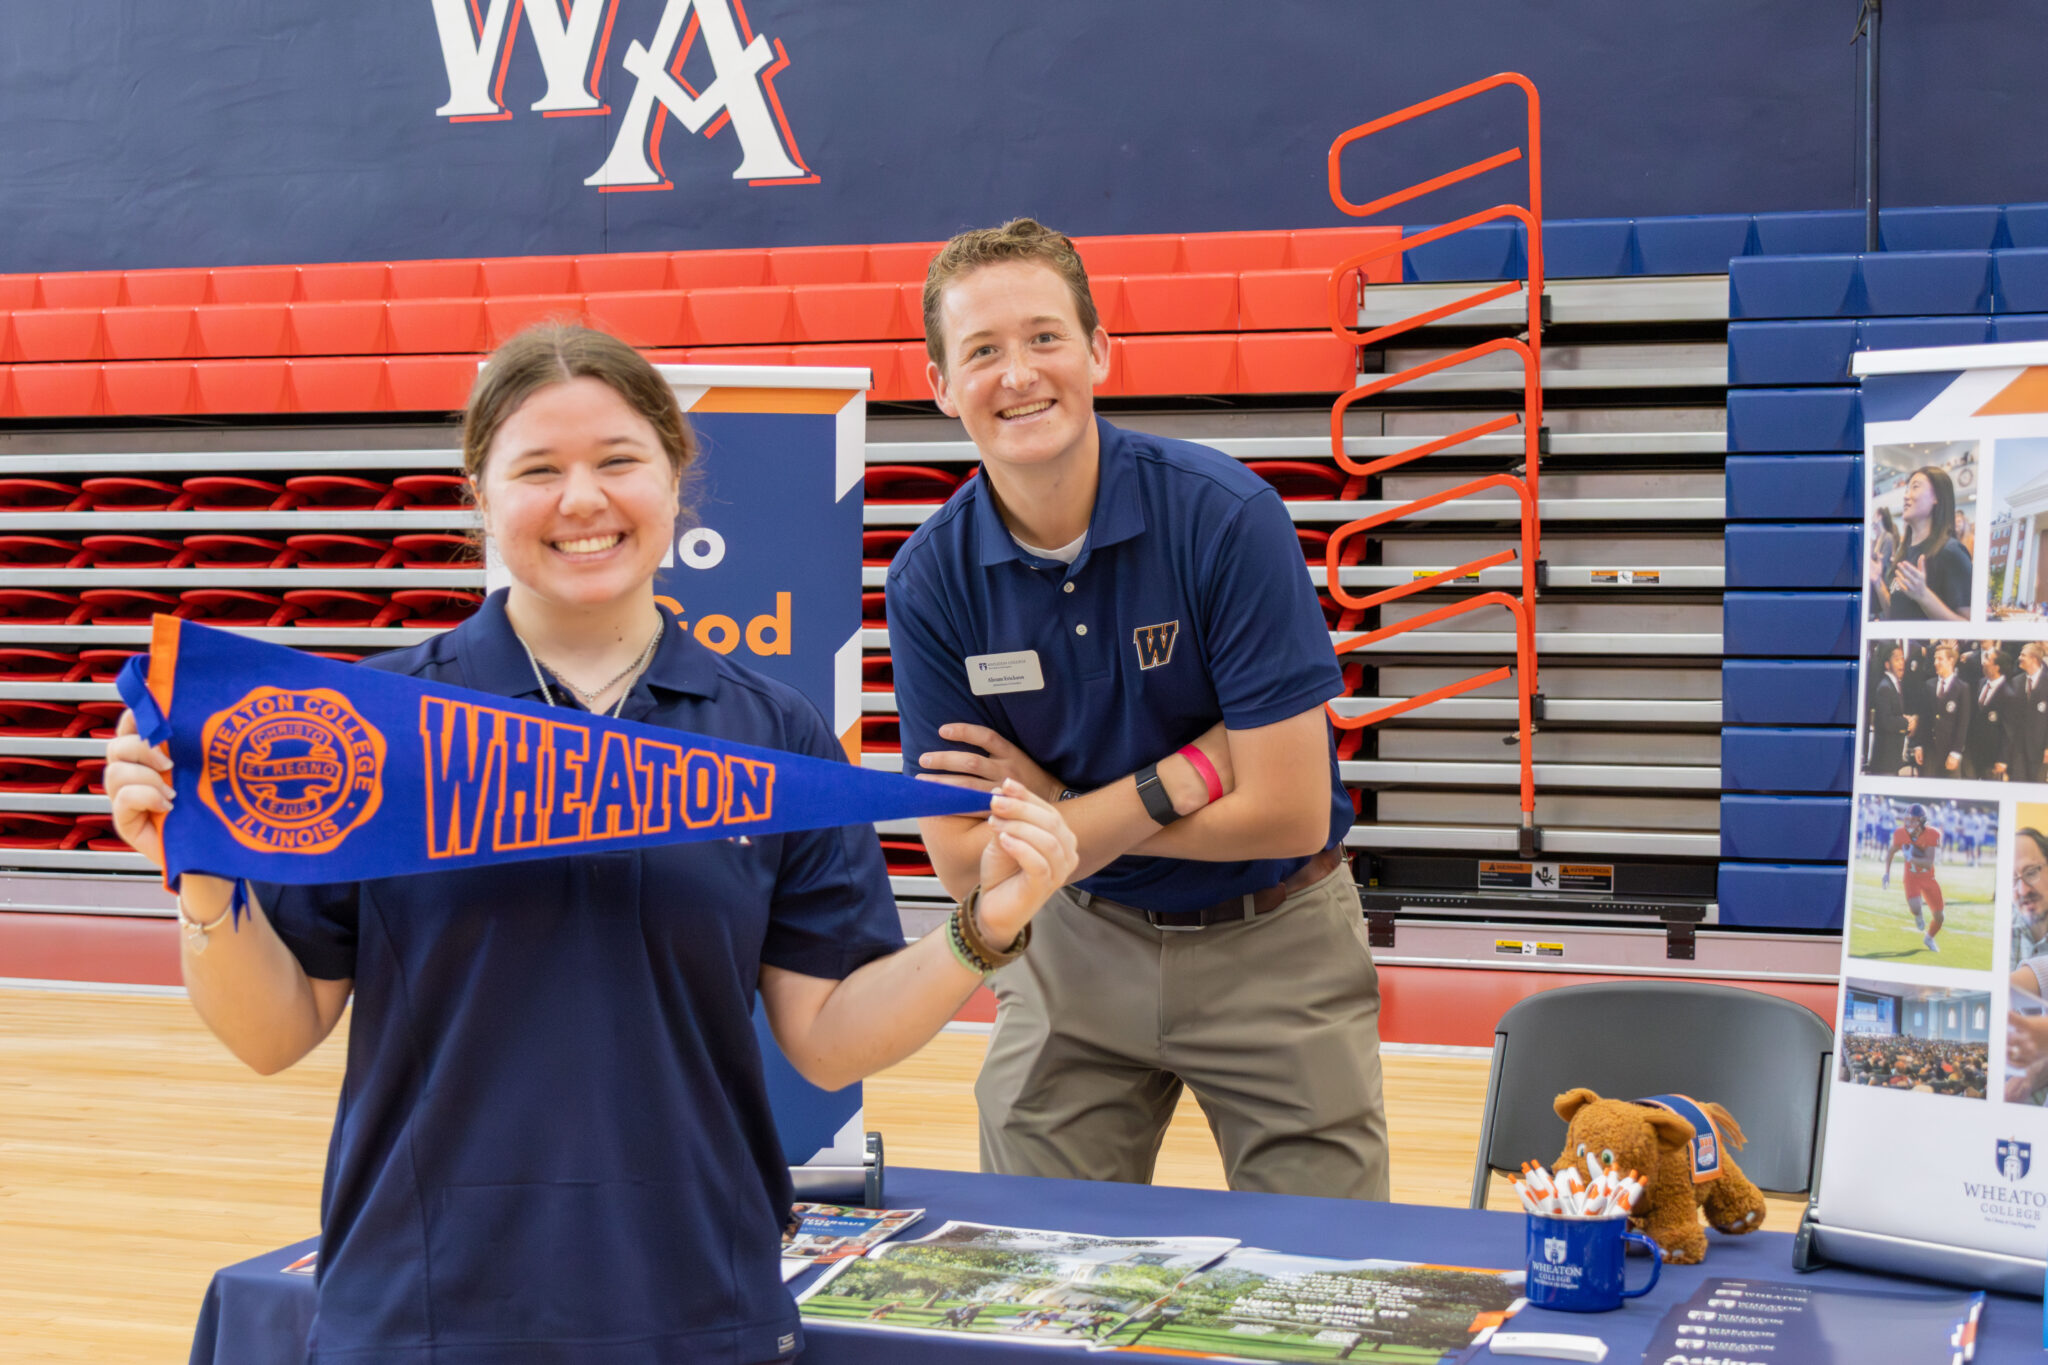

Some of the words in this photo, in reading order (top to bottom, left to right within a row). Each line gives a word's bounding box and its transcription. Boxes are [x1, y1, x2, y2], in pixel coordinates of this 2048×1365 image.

[1133, 619, 1179, 670] W
[208, 694, 295, 784] WHEATON
[303, 697, 375, 793] COLLEGE
[255, 724, 325, 744] CHRISTO
[245, 764, 266, 777] ET
[272, 762, 336, 777] REGNO
[419, 695, 775, 859] WHEATON
[268, 801, 311, 816] EJUS
[234, 813, 340, 848] ILLINOIS
[1979, 1202, 2041, 1221] COLLEGE
[1532, 1261, 1582, 1277] WHEATON
